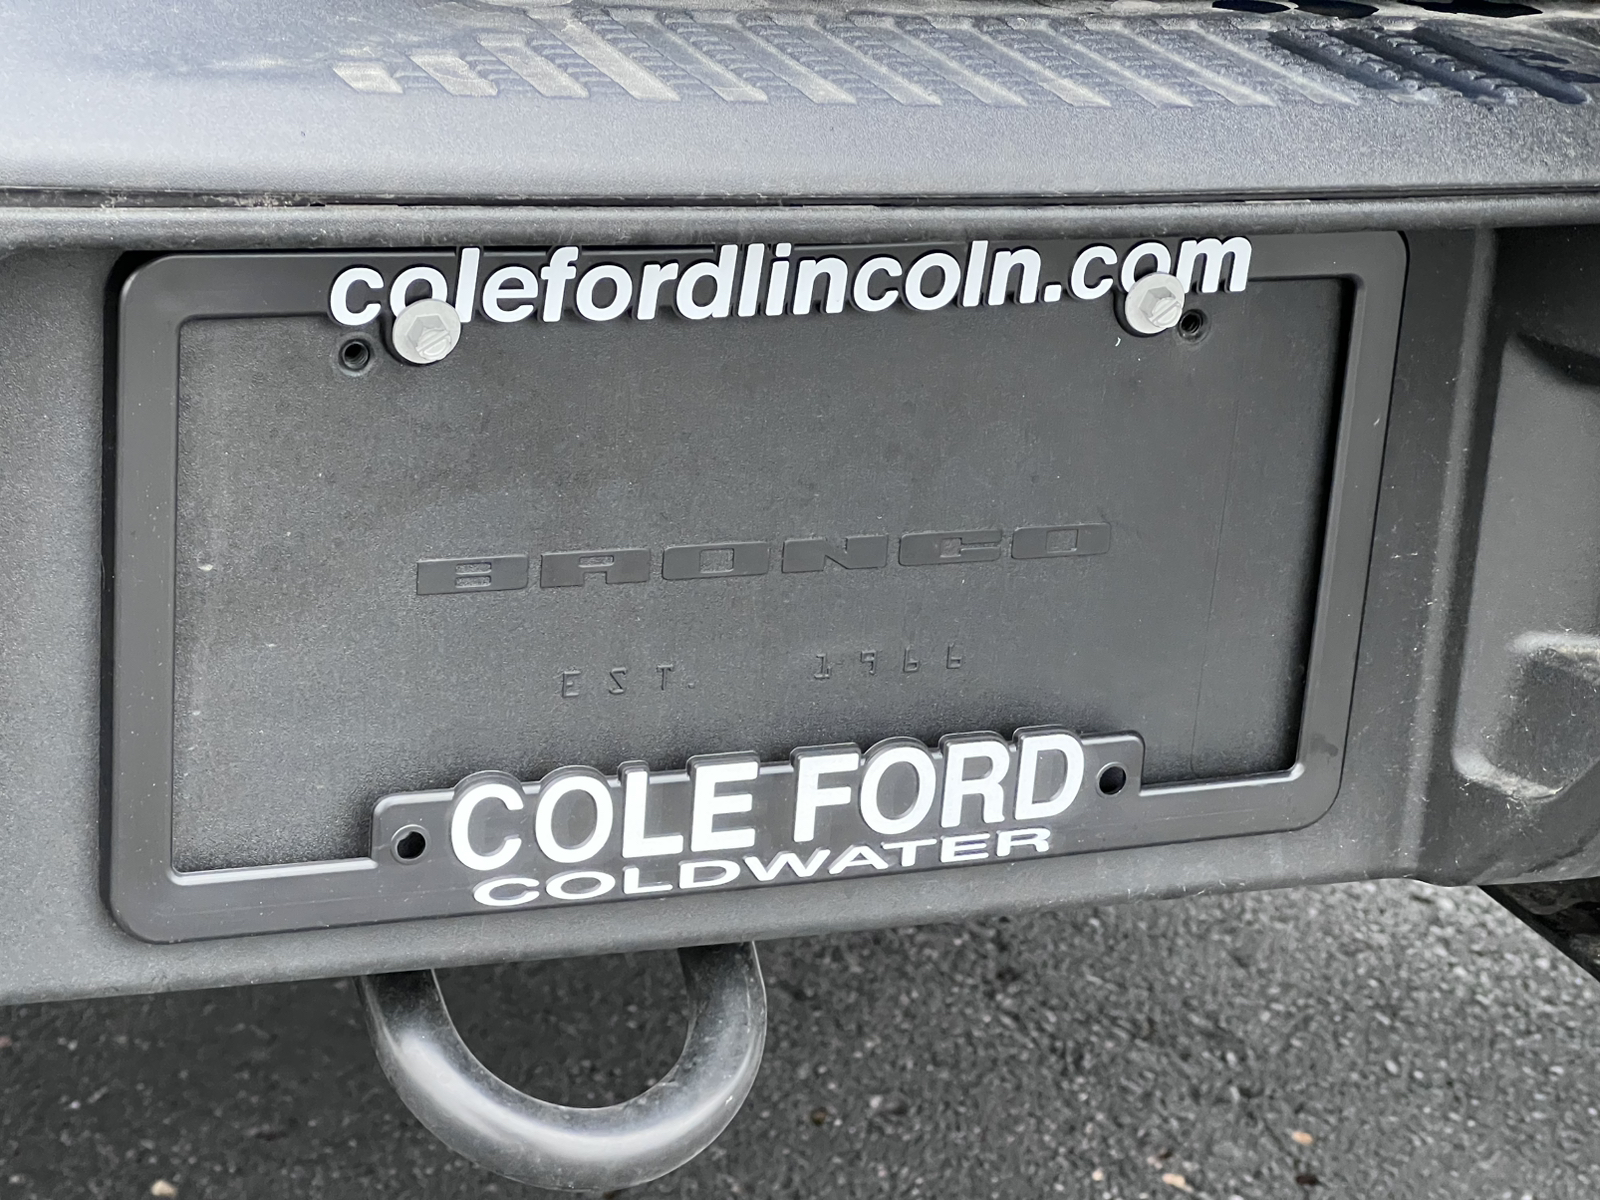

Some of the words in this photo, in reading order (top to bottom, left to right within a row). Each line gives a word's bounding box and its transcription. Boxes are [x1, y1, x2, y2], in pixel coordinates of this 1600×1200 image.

[330, 236, 1252, 326] colefordlincoln.com
[416, 522, 1111, 595] BRONCO
[813, 643, 963, 679] 1966
[450, 760, 759, 871] COLE
[793, 733, 1085, 842] FORD
[473, 826, 1051, 907] COLDWATER
